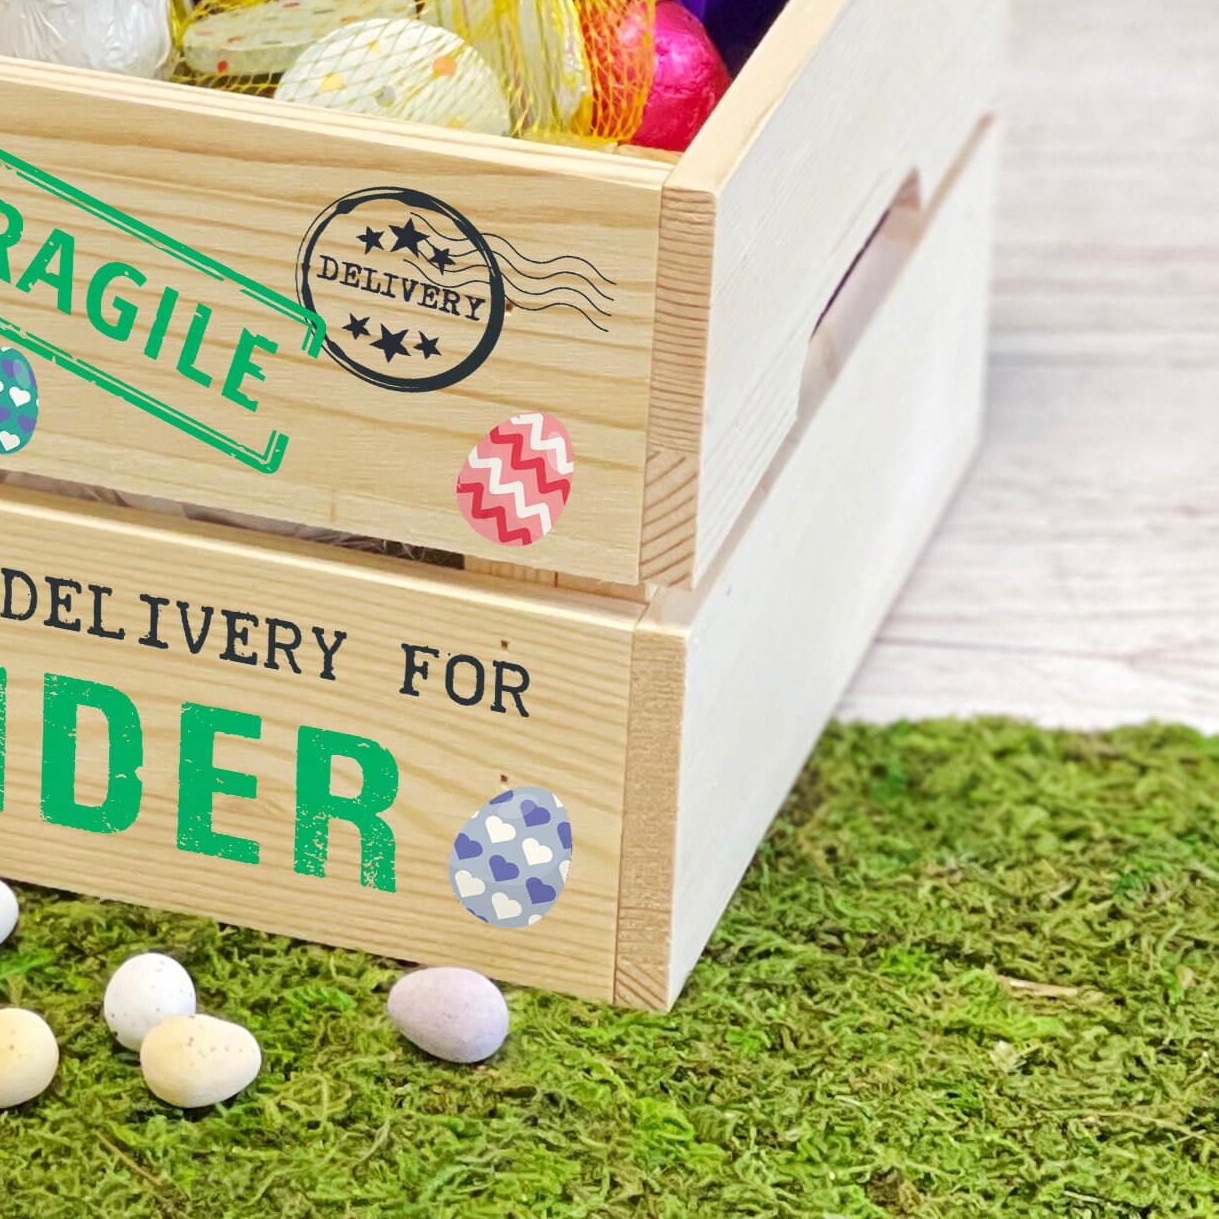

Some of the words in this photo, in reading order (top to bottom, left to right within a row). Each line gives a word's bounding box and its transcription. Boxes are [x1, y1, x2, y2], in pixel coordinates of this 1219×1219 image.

[316, 254, 486, 322] DELIVERY
[0, 567, 347, 681] DELIVERY
[399, 643, 530, 718] FOR
